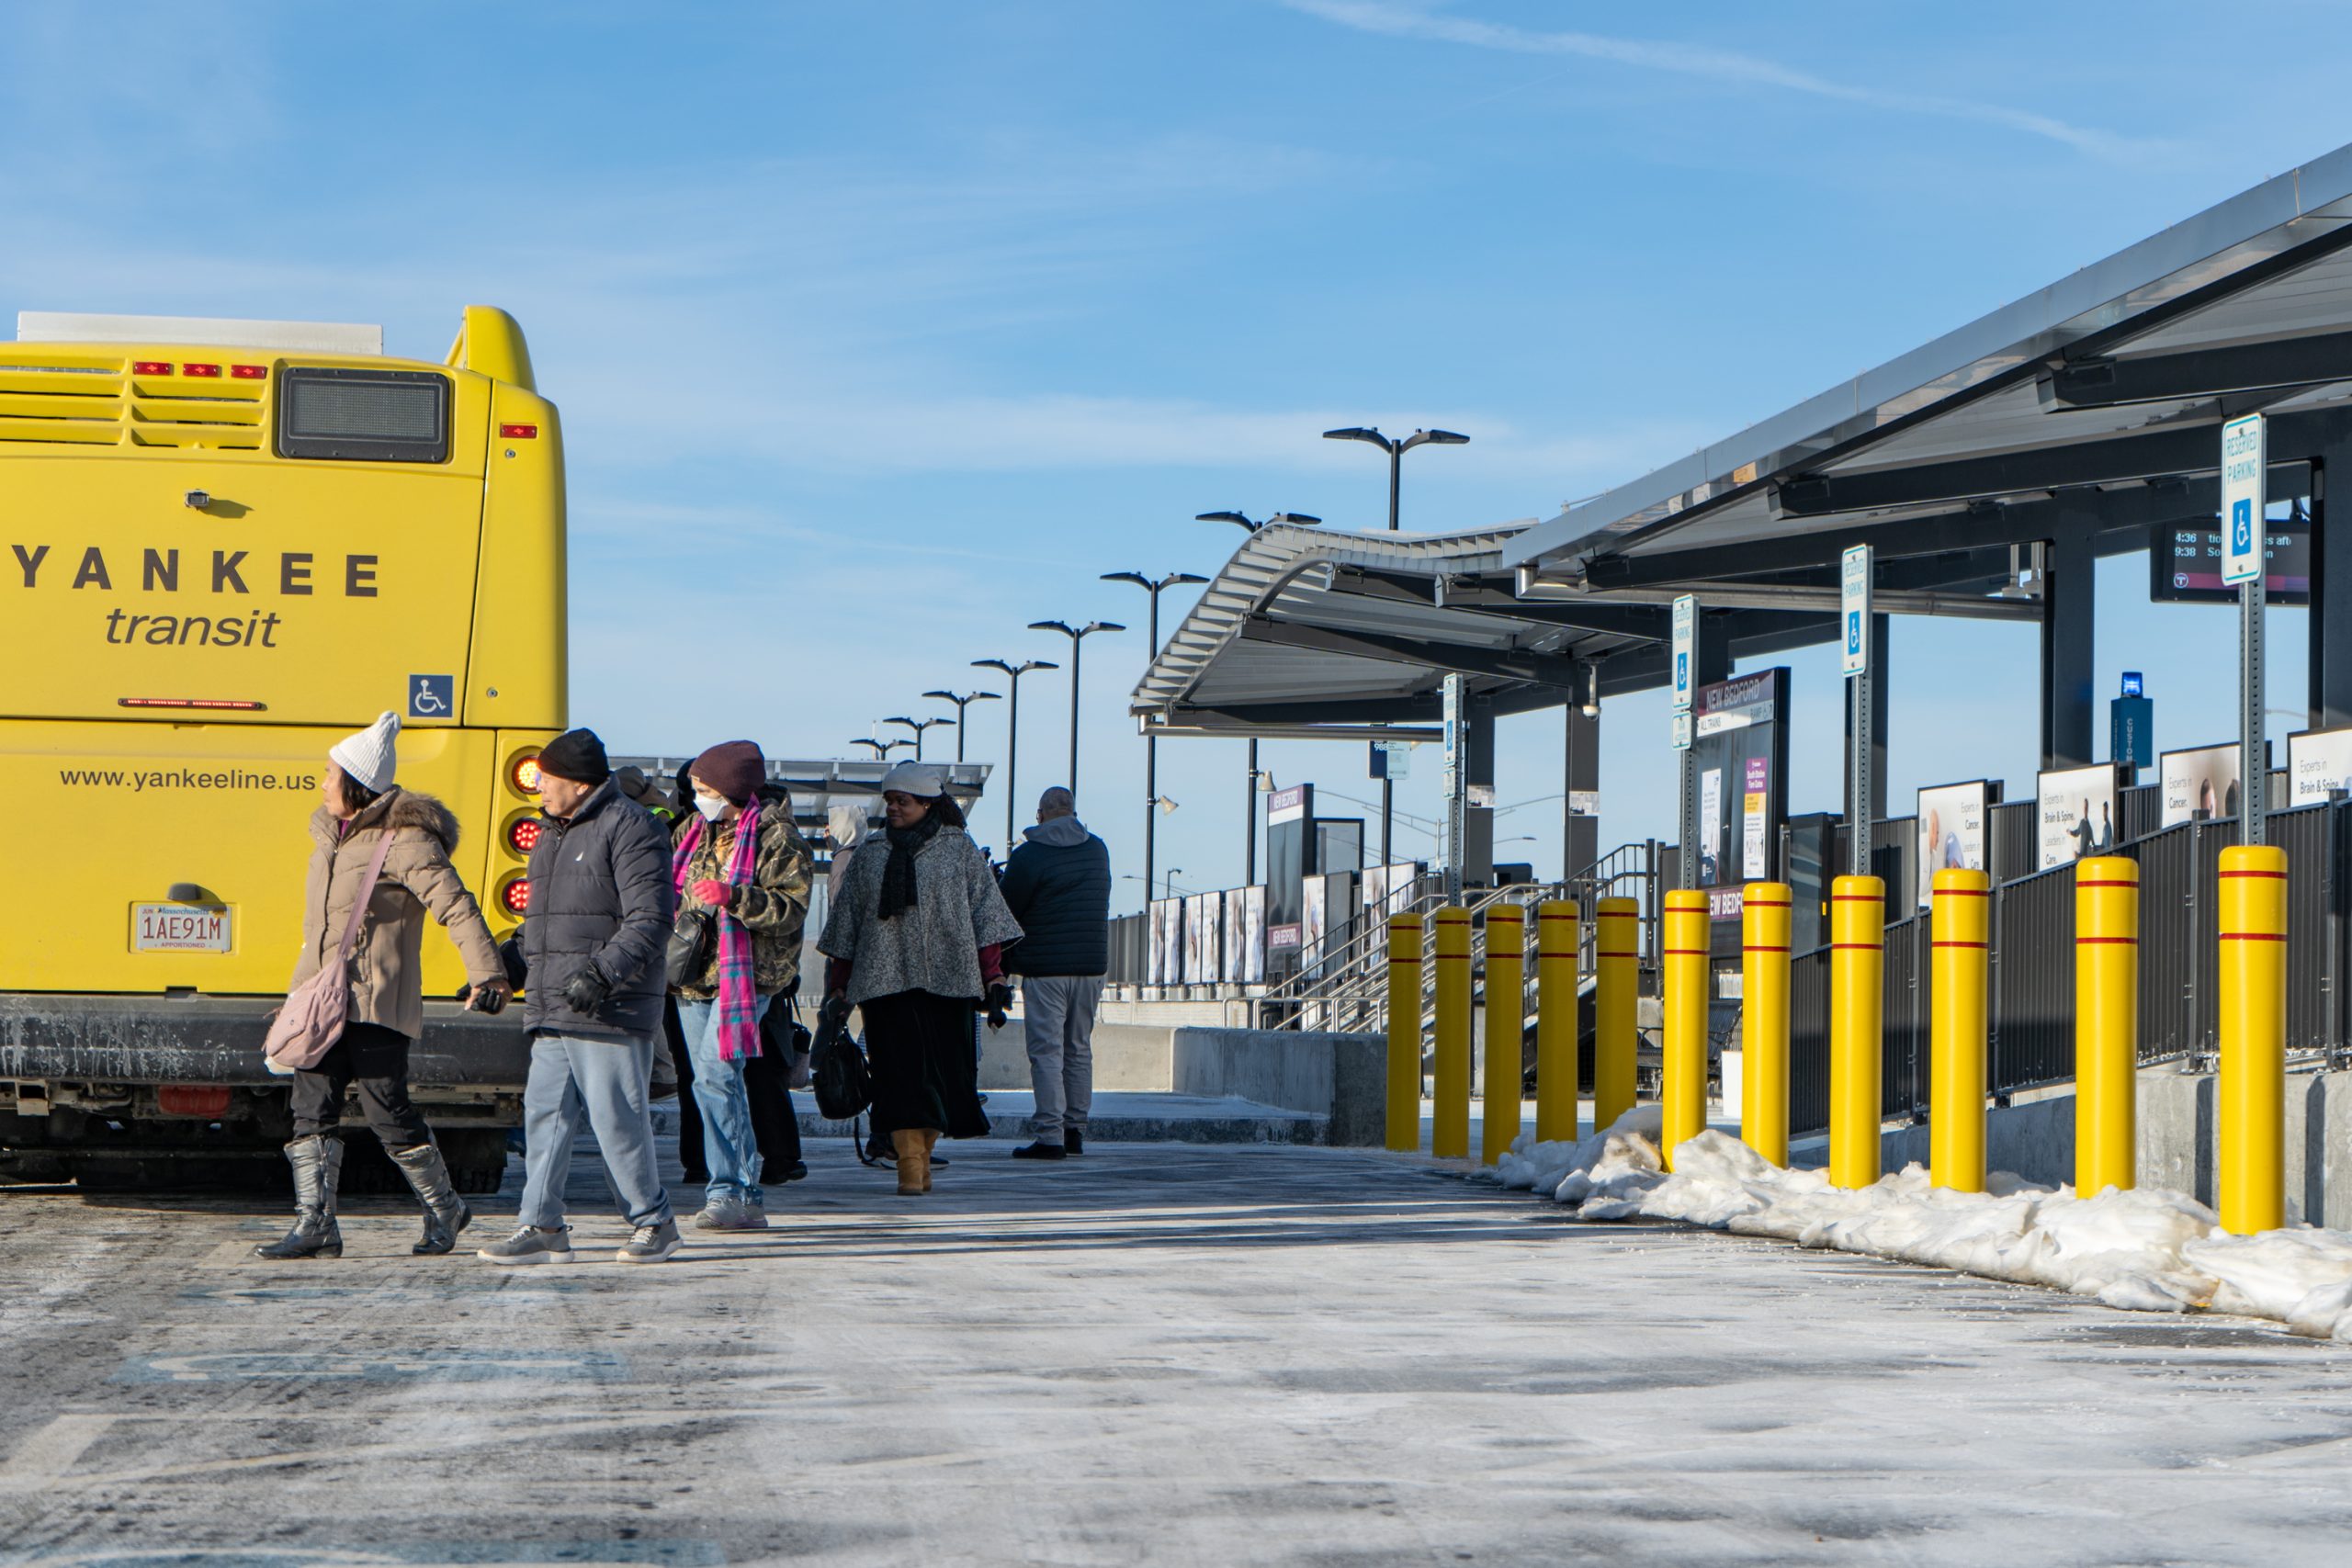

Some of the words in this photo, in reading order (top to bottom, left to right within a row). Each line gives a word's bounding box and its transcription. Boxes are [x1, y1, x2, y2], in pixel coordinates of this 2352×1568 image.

[2226, 431, 2257, 457] RESERVED
[2227, 458, 2256, 485] PARKING
[11, 545, 379, 597] YANKEE
[106, 608, 281, 648] transit
[1706, 687, 1724, 712] NEW
[1724, 678, 1760, 707] BEDFORD
[60, 769, 316, 792] www.yankeeline.us
[2300, 781, 2314, 795] Brain
[2316, 779, 2321, 793] &
[2044, 811, 2055, 823] Brain
[159, 906, 209, 916] Massachusetts
[1709, 894, 1721, 917] EW
[1722, 892, 1744, 915] BEDF
[143, 917, 220, 940] 1AE91M
